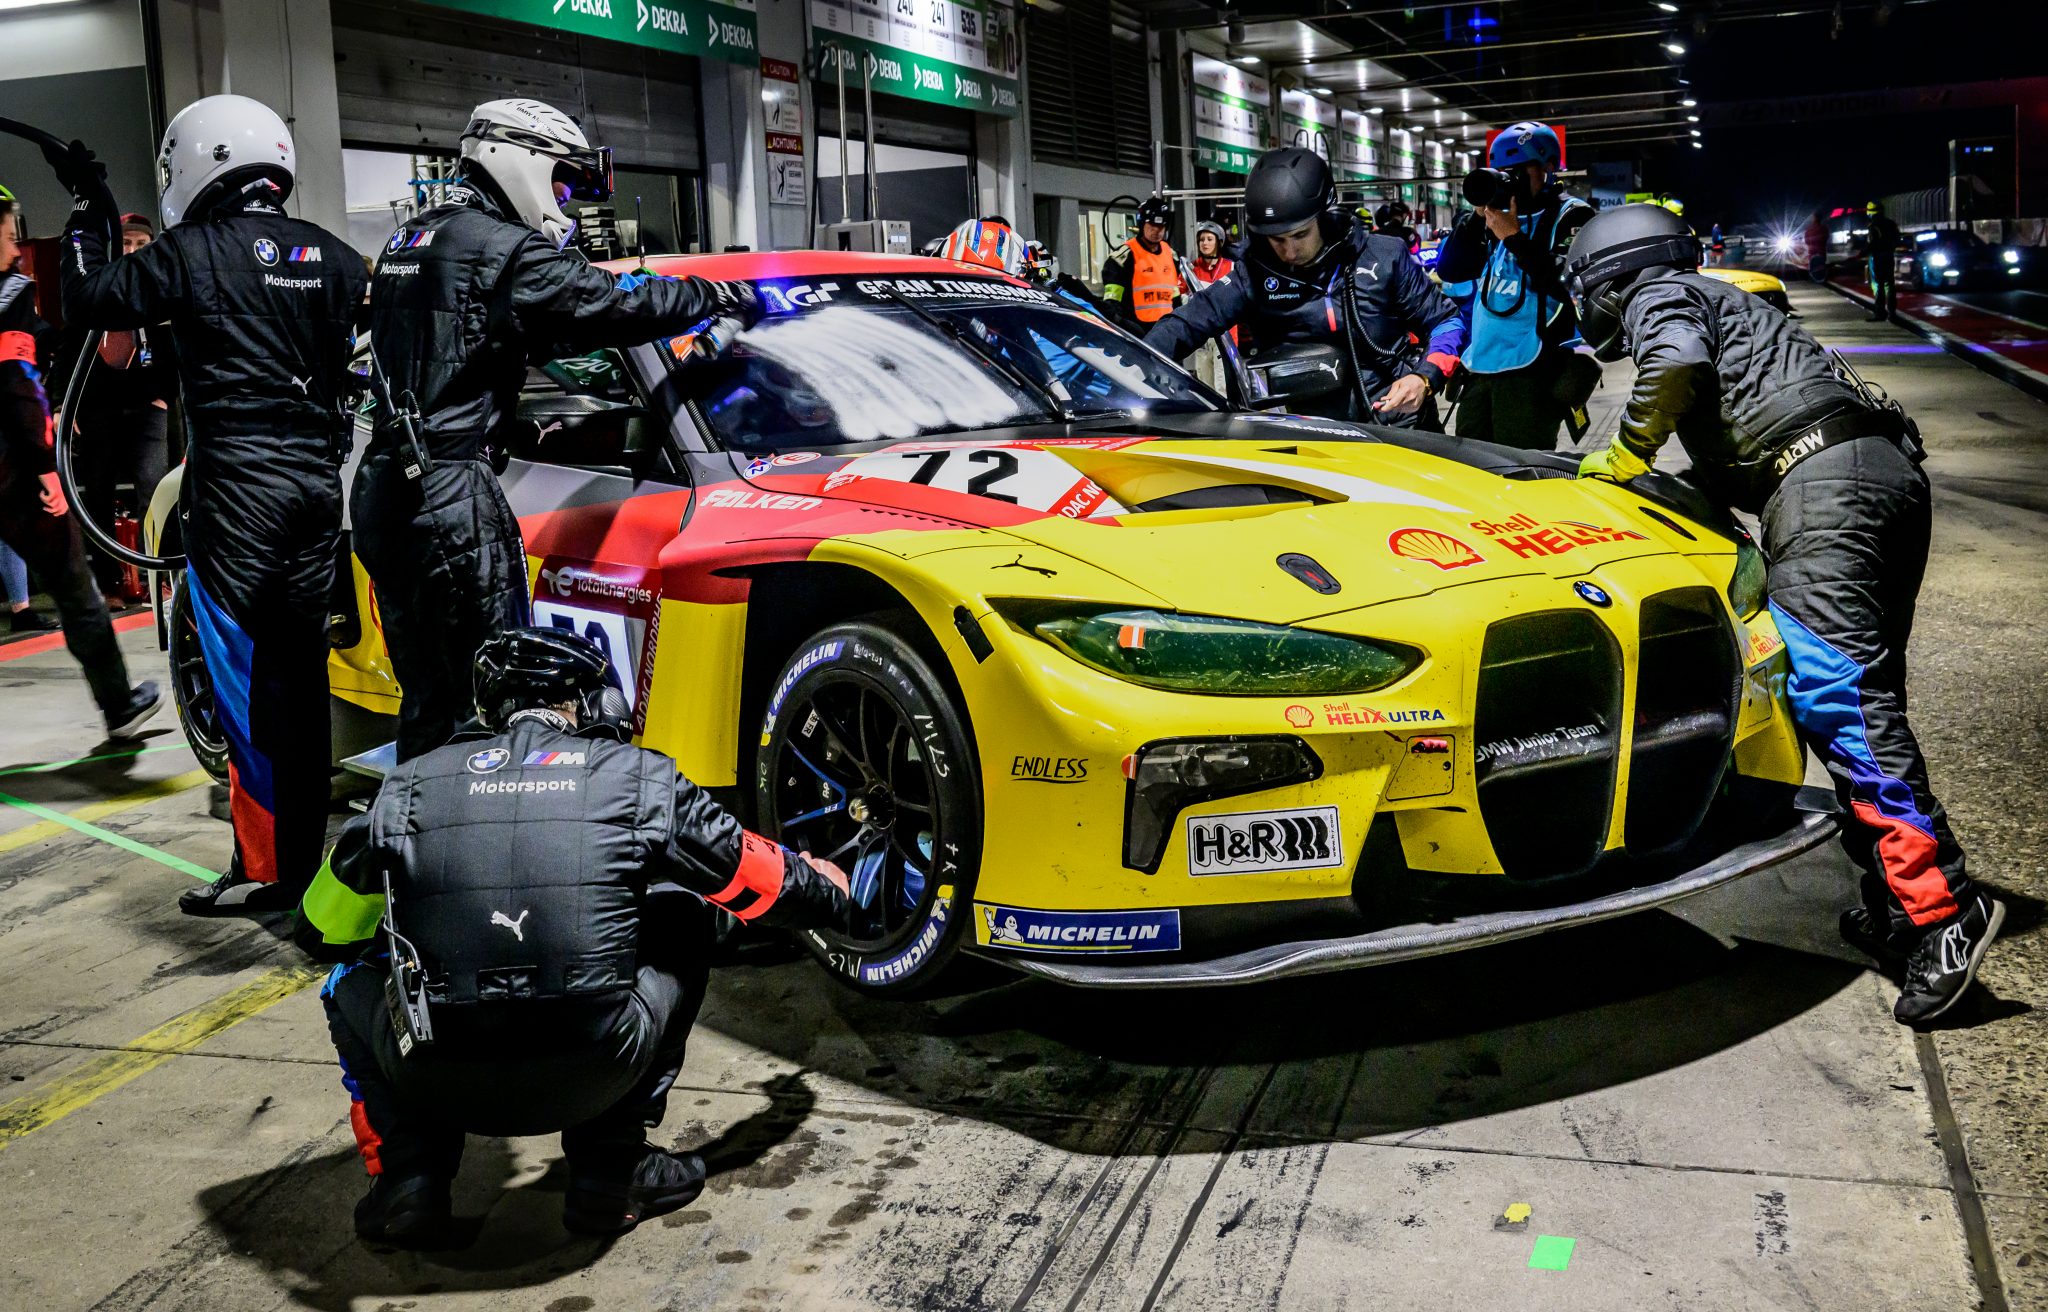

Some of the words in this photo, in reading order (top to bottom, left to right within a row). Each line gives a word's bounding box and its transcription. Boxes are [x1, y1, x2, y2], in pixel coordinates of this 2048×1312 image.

[651, 5, 688, 36] DEKRA
[961, 9, 976, 37] 535
[722, 22, 754, 49] DEKRA
[879, 58, 903, 81] DEKRA
[922, 68, 944, 91] DEKRA
[962, 79, 982, 100] DEKRA
[772, 137, 797, 151] ACHTUNG
[264, 273, 322, 290] Motorsport
[380, 263, 420, 277] Motorsport
[1268, 293, 1300, 301] Motorsport
[1774, 428, 1824, 476] MRTC
[902, 450, 1018, 504] 72
[700, 489, 824, 511] FALKEN
[1470, 513, 1539, 536] Shell
[1494, 523, 1649, 559] HELIX
[577, 574, 652, 604] TotalEnergies
[773, 642, 837, 710] MICHELIN
[1323, 702, 1350, 713] Shell
[1326, 708, 1389, 726] HELIX
[1388, 709, 1445, 722] ULTRA
[1515, 728, 1560, 753] Junior
[1555, 722, 1600, 745] Team
[1011, 755, 1090, 779] ENDLESS
[469, 779, 576, 795] Motorsport
[1194, 822, 1284, 866] H&R
[1026, 923, 1161, 942] MICHELIN
[867, 921, 938, 981] MICHELIN
